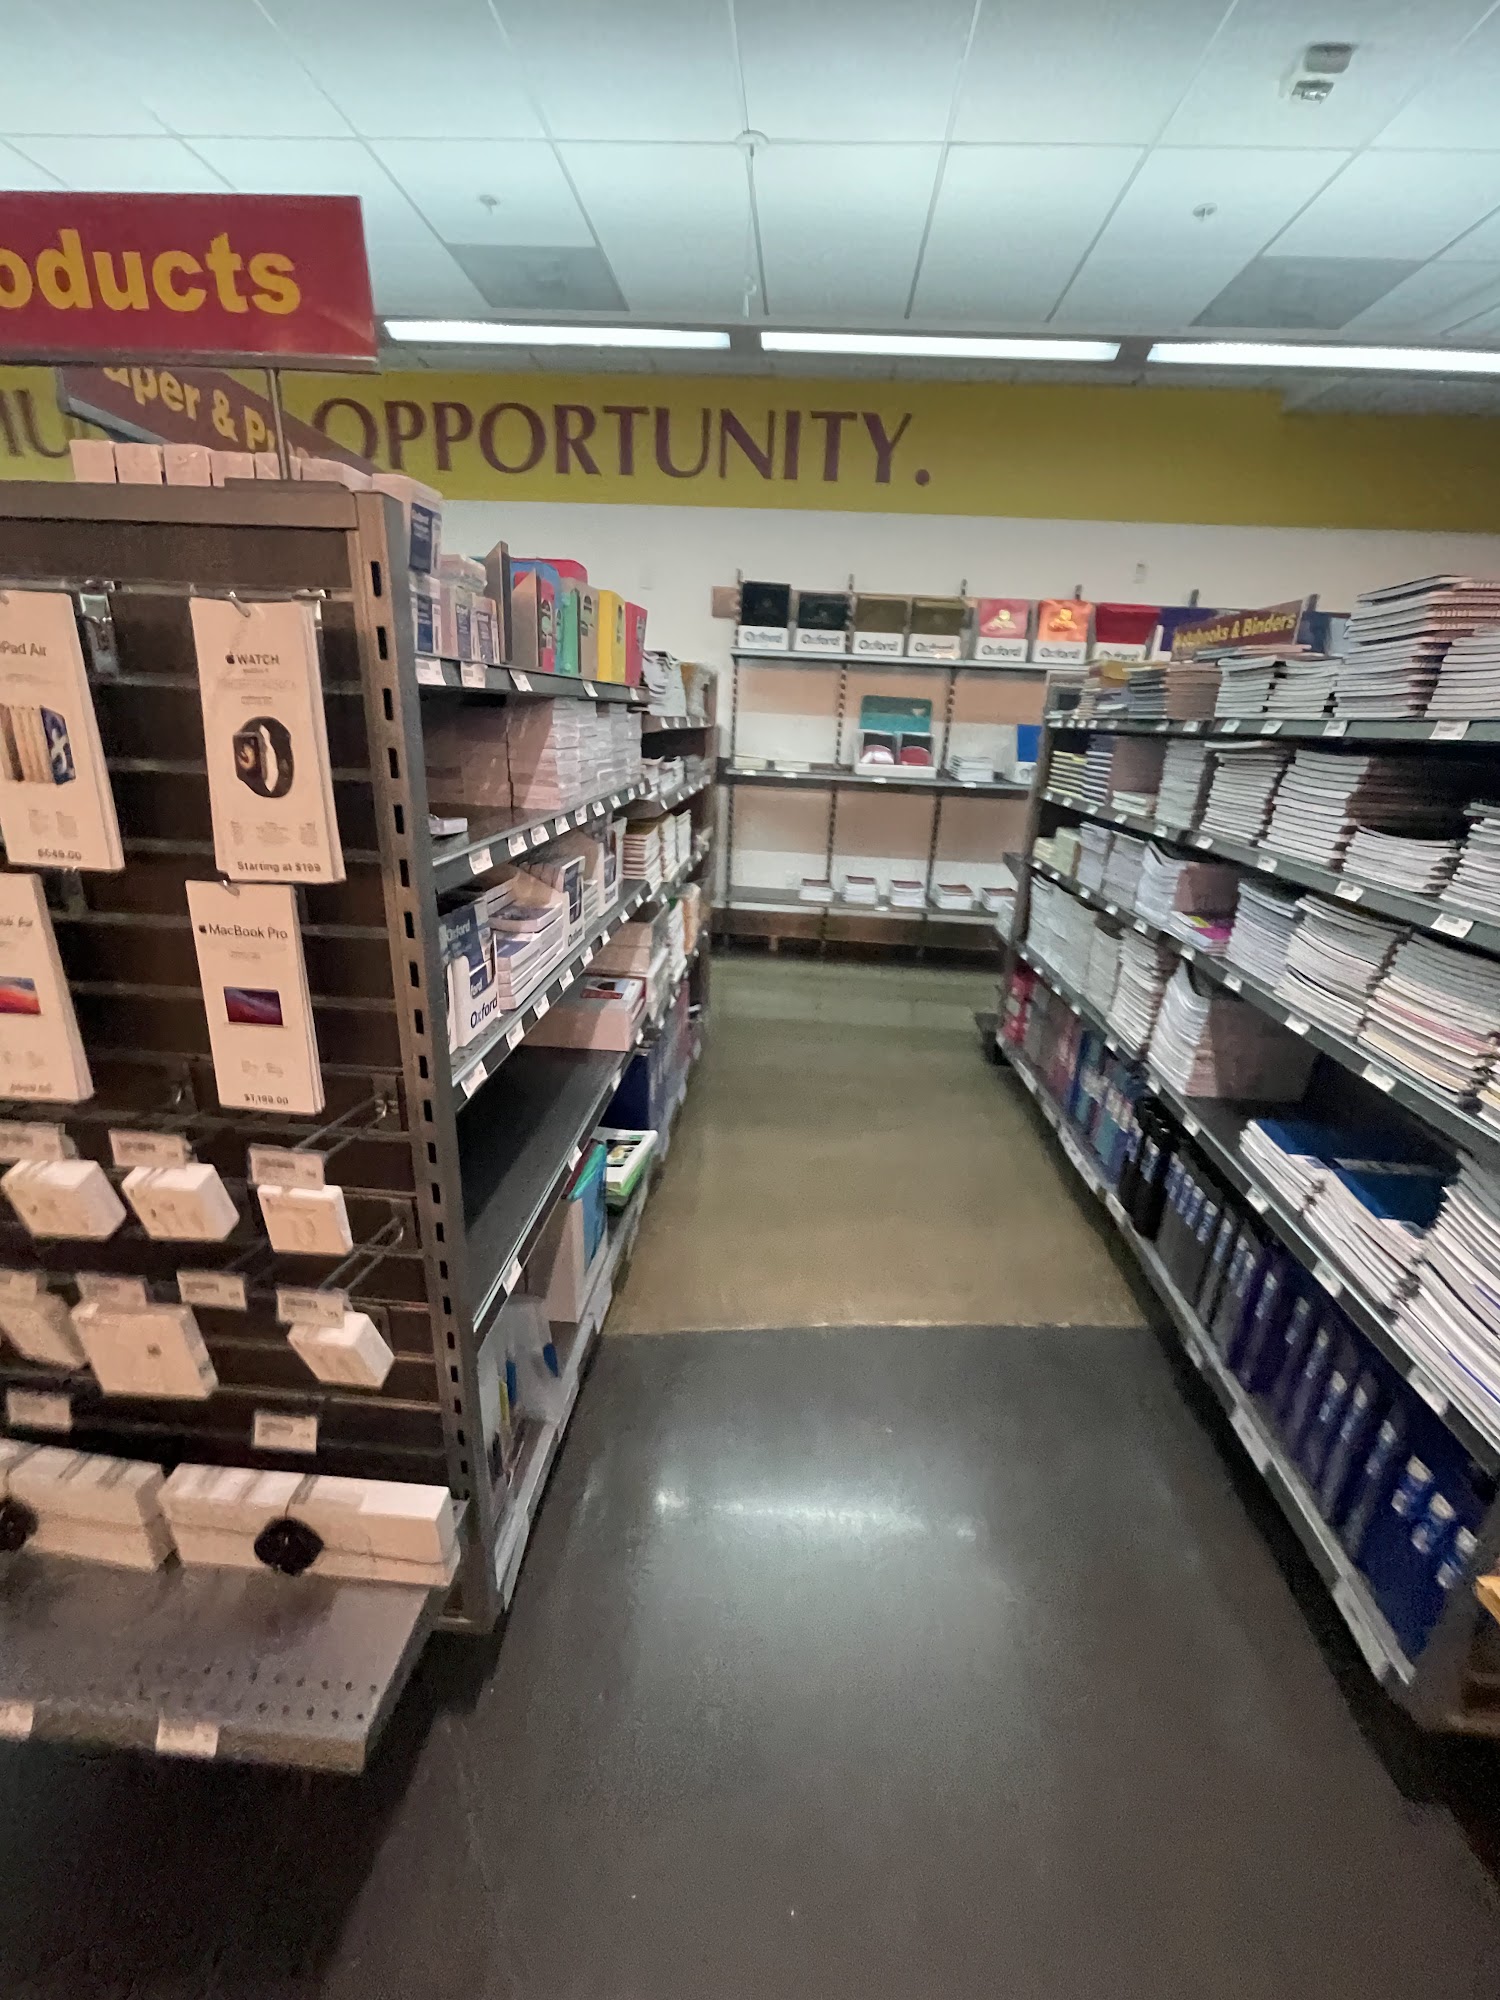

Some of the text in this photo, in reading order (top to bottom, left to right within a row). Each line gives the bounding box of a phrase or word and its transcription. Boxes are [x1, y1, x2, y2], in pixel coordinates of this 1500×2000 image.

[312, 397, 931, 487] OPPORTUNITY.
[237, 654, 280, 665] WATCH
[237, 861, 280, 873] Starting
[282, 863, 293, 872] at
[208, 923, 288, 939] MacBook Pro
[470, 992, 498, 1029] Oxford
